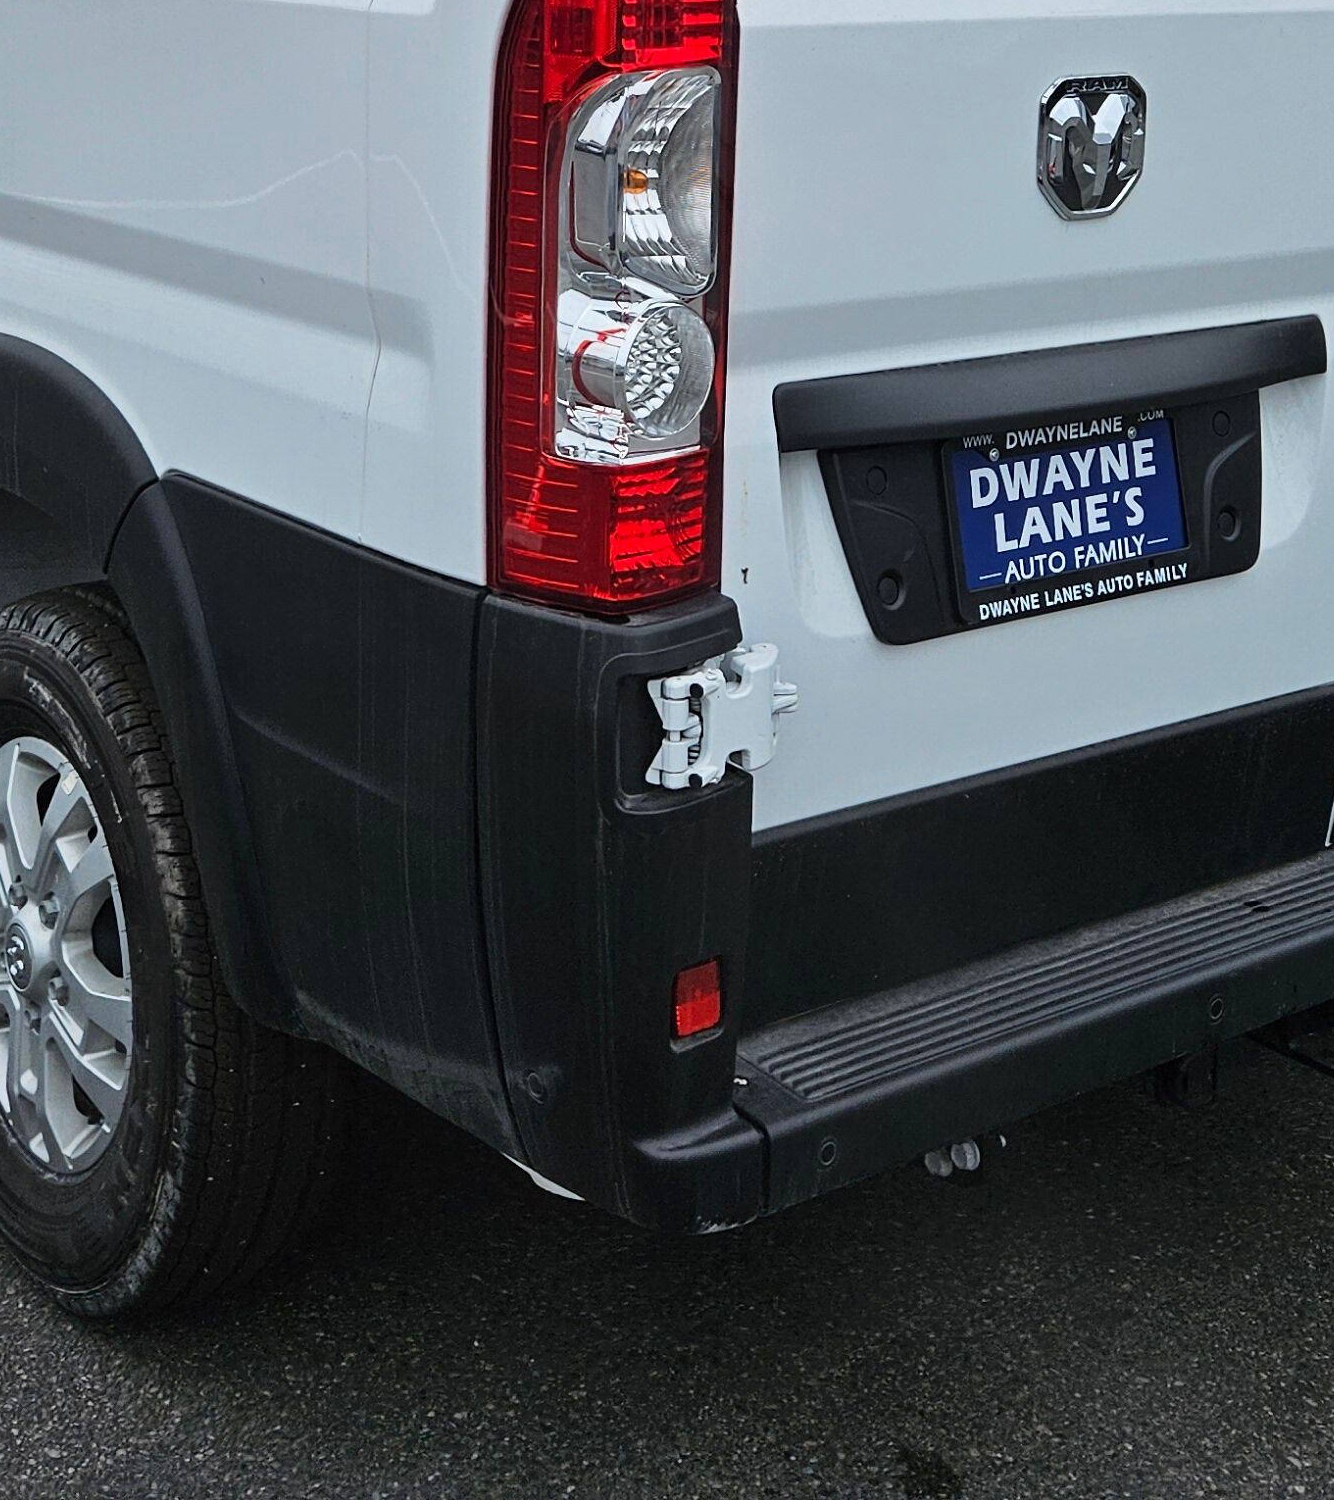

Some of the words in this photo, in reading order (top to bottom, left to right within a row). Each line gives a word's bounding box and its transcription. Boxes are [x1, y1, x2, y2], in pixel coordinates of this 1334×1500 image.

[1066, 77, 1129, 93] RAM
[962, 433, 995, 449] WWW.
[1005, 416, 1123, 450] DWAYNELANE
[969, 438, 1157, 509] DWAYNE
[993, 487, 1146, 553] LANE'S
[1004, 551, 1066, 584] AUTO
[1074, 534, 1146, 569] FAMILY
[979, 593, 1041, 621] DWAYNE
[1044, 583, 1094, 607] LANE'S
[1097, 575, 1134, 596] AUTO
[1136, 563, 1189, 588] FAMILY
